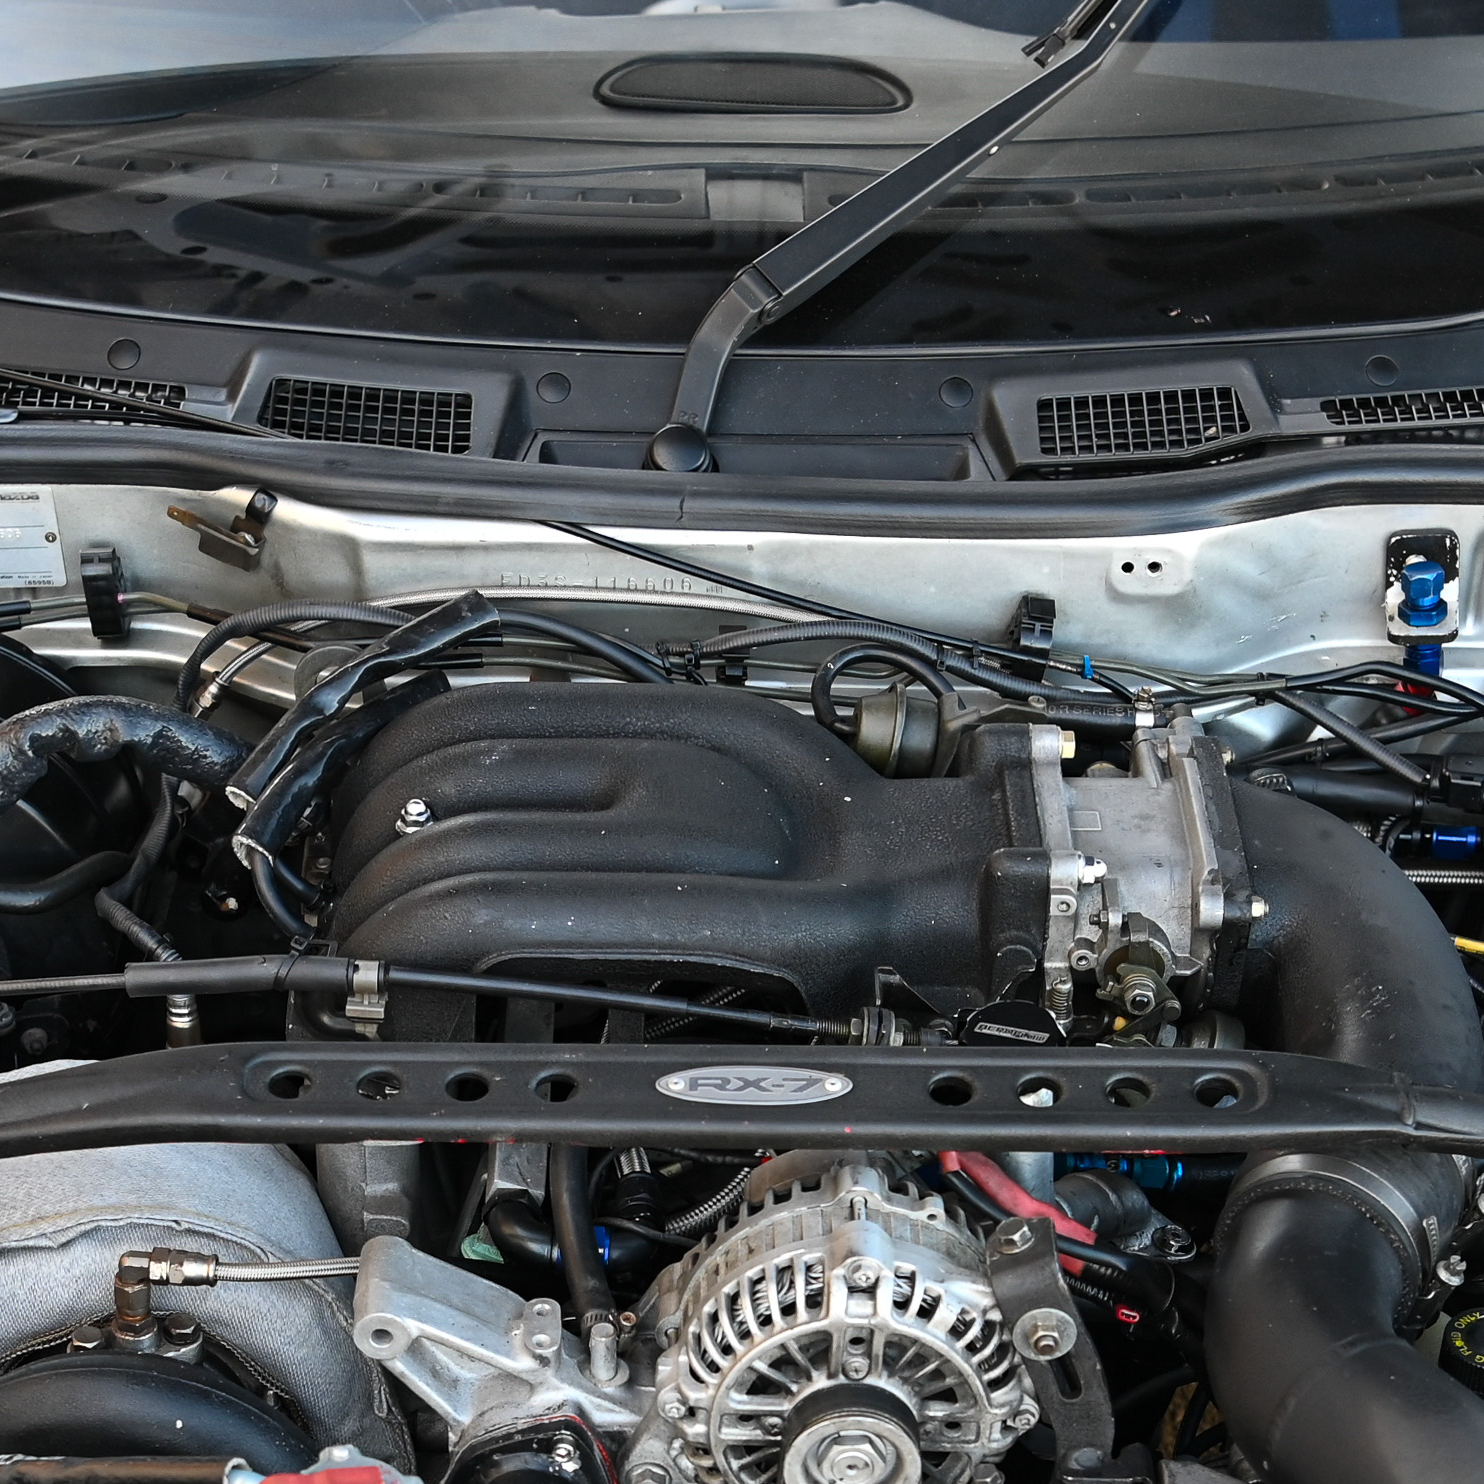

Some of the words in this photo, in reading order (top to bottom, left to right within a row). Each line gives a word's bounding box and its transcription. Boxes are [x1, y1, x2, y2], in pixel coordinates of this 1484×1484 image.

[500, 573, 692, 592] FD3S-116606
[689, 1076, 823, 1093] RX-7
[1454, 1312, 1482, 1329] ONLY
